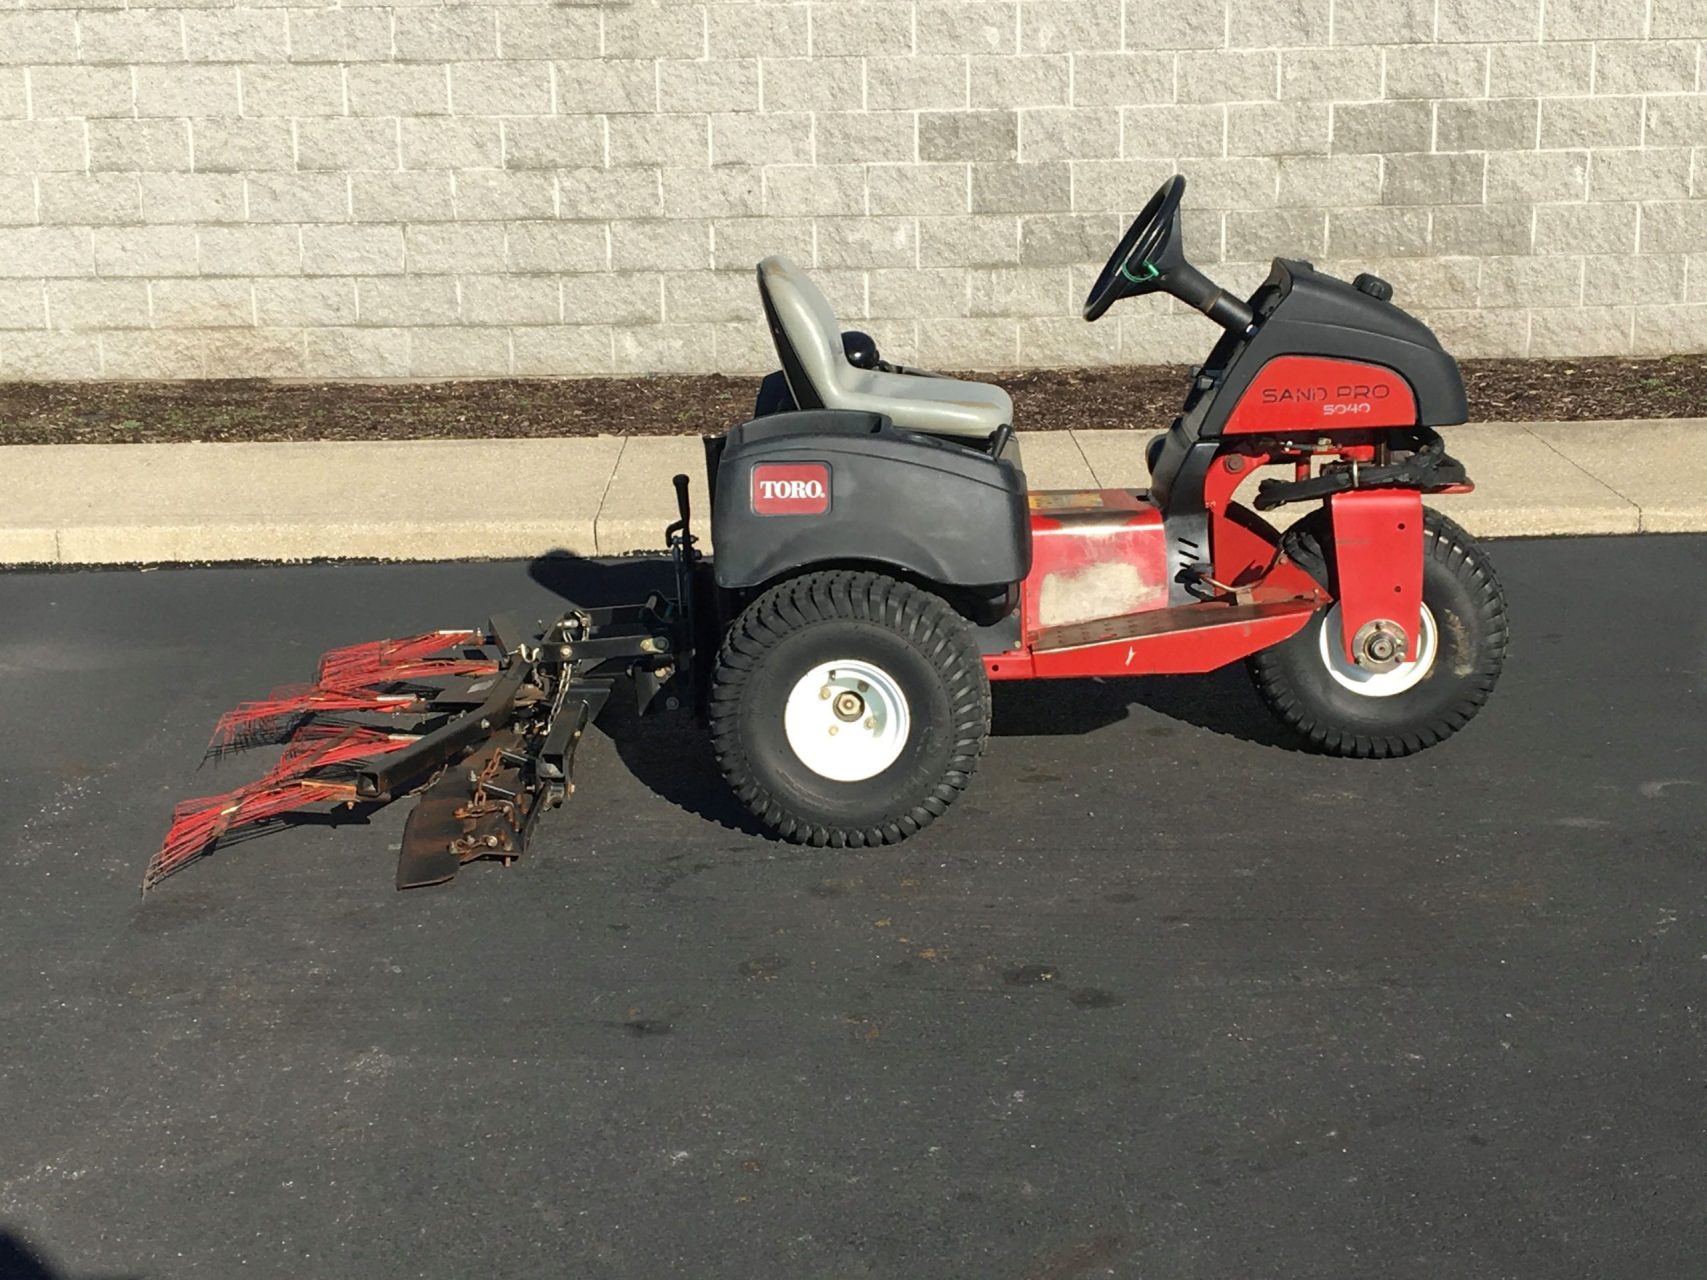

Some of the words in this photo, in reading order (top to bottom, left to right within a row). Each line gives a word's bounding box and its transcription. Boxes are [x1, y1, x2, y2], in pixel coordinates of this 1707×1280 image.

[1262, 387, 1328, 403] SAND
[1337, 384, 1391, 399] PRO
[1323, 403, 1371, 415] 5040
[760, 480, 824, 499] TORO
